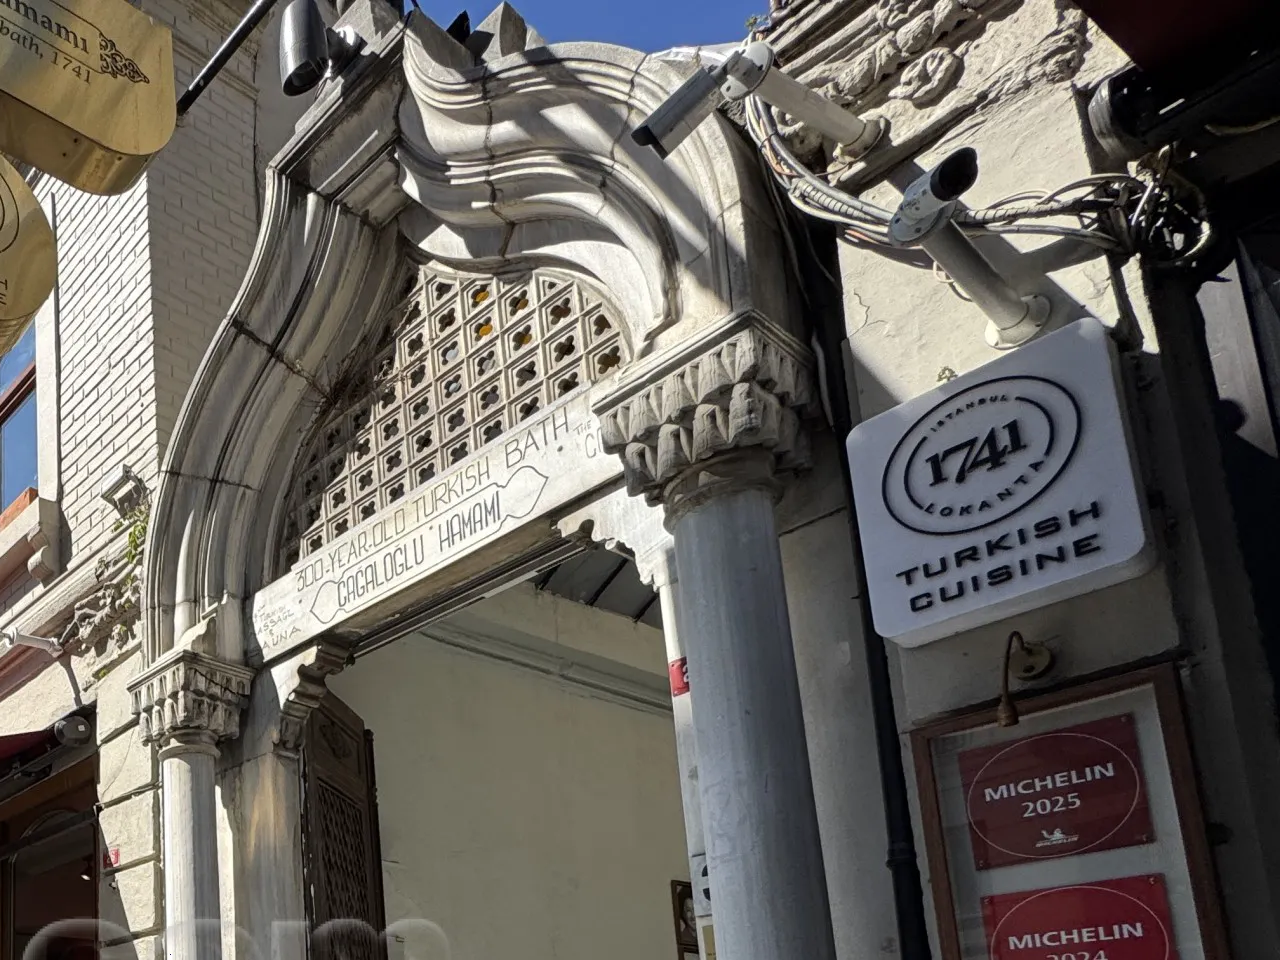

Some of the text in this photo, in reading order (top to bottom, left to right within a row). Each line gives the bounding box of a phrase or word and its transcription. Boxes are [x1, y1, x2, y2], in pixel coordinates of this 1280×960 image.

[0, 20, 43, 59] bath,
[51, 51, 91, 84] 1741
[412, 456, 490, 522] TURKISH
[504, 406, 570, 468] BATH
[925, 418, 1027, 487] 1741
[924, 460, 1044, 516] LOKANTA
[438, 490, 502, 552] HAMAMI
[896, 501, 1100, 585] TURKISH
[909, 534, 1101, 613] CUISINE
[258, 609, 294, 635] ASSAGE
[263, 626, 301, 649] AUNA
[984, 762, 1115, 802] MICHELIN
[1022, 793, 1081, 818] 2025
[1008, 922, 1144, 950] MICHELIN
